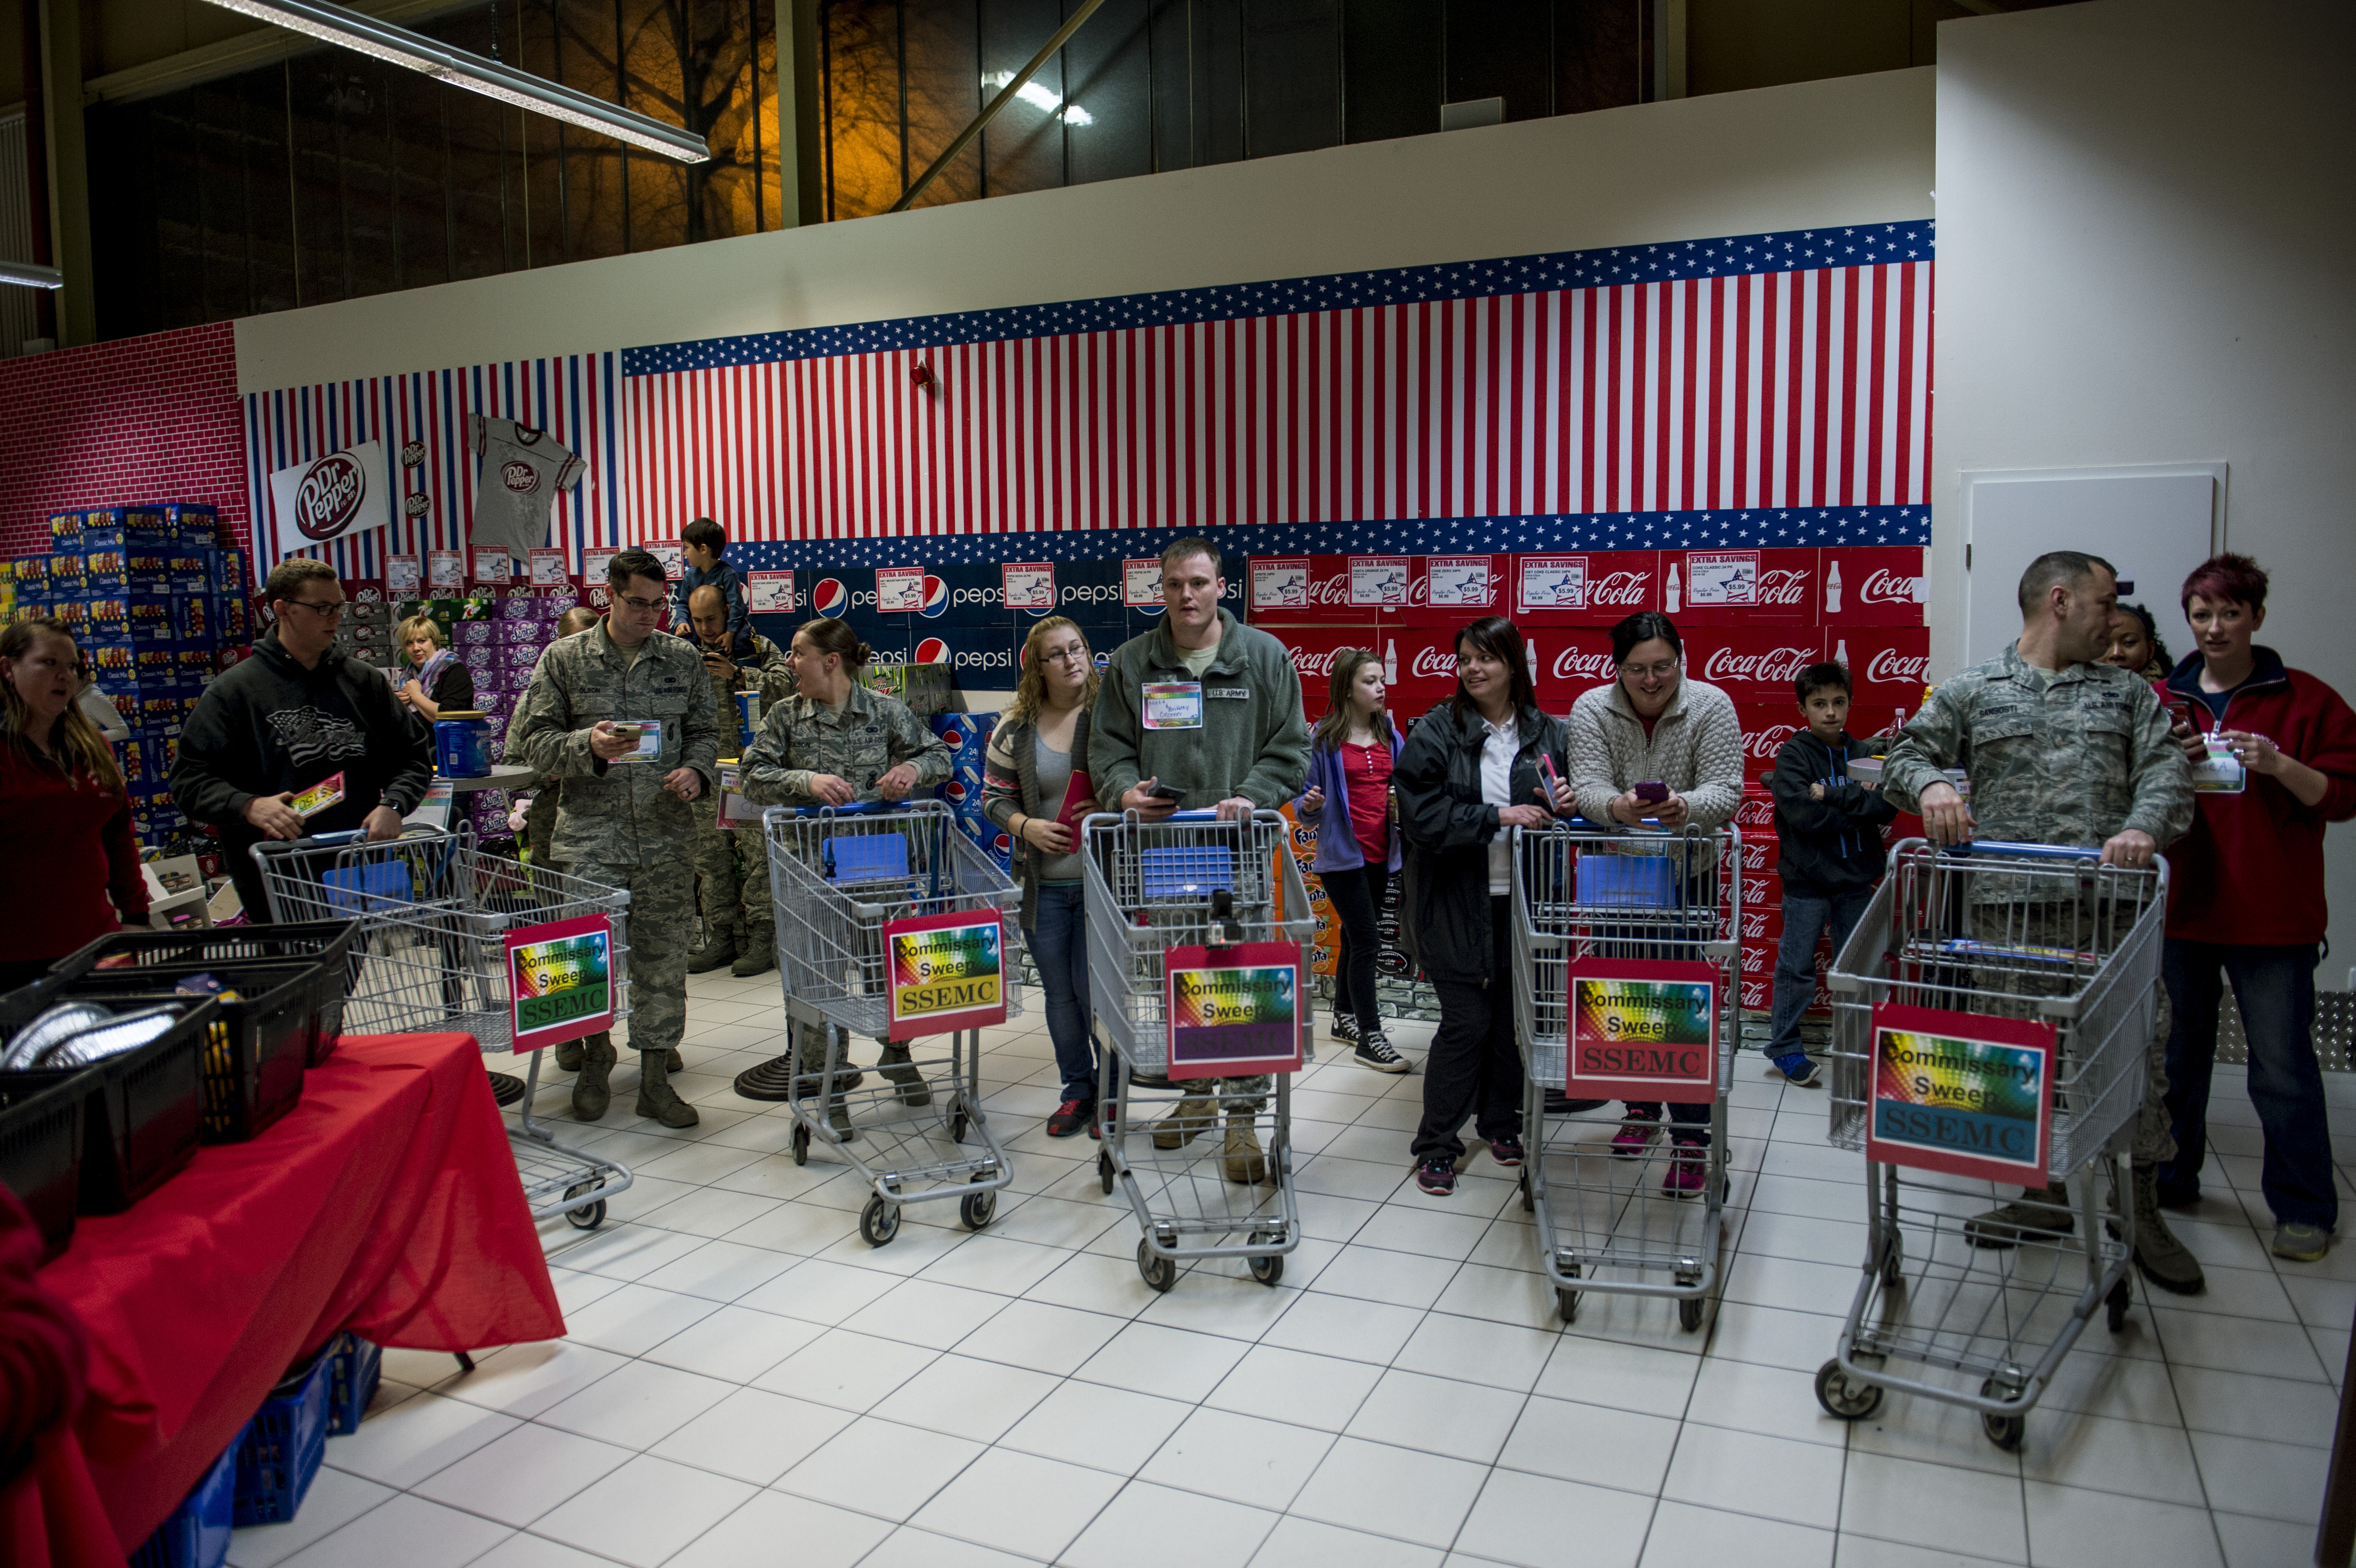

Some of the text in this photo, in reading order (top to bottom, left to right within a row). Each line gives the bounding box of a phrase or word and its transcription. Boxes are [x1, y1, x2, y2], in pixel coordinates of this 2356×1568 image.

[403, 446, 425, 465] Pepper
[411, 444, 420, 452] Dr
[316, 462, 340, 496] Dr
[506, 466, 534, 487] Pepper
[517, 467, 528, 477] Dr
[304, 467, 358, 528] Pepper
[406, 497, 429, 514] Pepper
[415, 494, 424, 503] Dr
[953, 588, 1003, 608] peps
[1061, 580, 1123, 606] pepsi
[504, 600, 529, 619] Sunkist
[465, 625, 491, 643] Sunkist
[511, 623, 539, 642] Sunkist
[467, 648, 491, 667] Sunkist
[512, 646, 540, 665] Sunkist
[956, 648, 1012, 670] pepsi
[517, 945, 605, 970] Commissary
[899, 937, 995, 958] Commissary
[539, 969, 588, 989] Sweep
[920, 960, 975, 978] Sweep
[902, 981, 993, 1012] SSEMC
[1178, 979, 1290, 996] Commissary
[524, 989, 603, 1024] SSEMC
[1579, 990, 1706, 1014] Commissary
[1203, 1003, 1265, 1022] Sweep
[1607, 1017, 1677, 1039] Sweep
[1583, 1047, 1701, 1074] SSEMC
[1884, 1042, 2035, 1085] Commissary
[1914, 1077, 1998, 1110] Sweep
[1885, 1108, 2024, 1154] SSEMC
